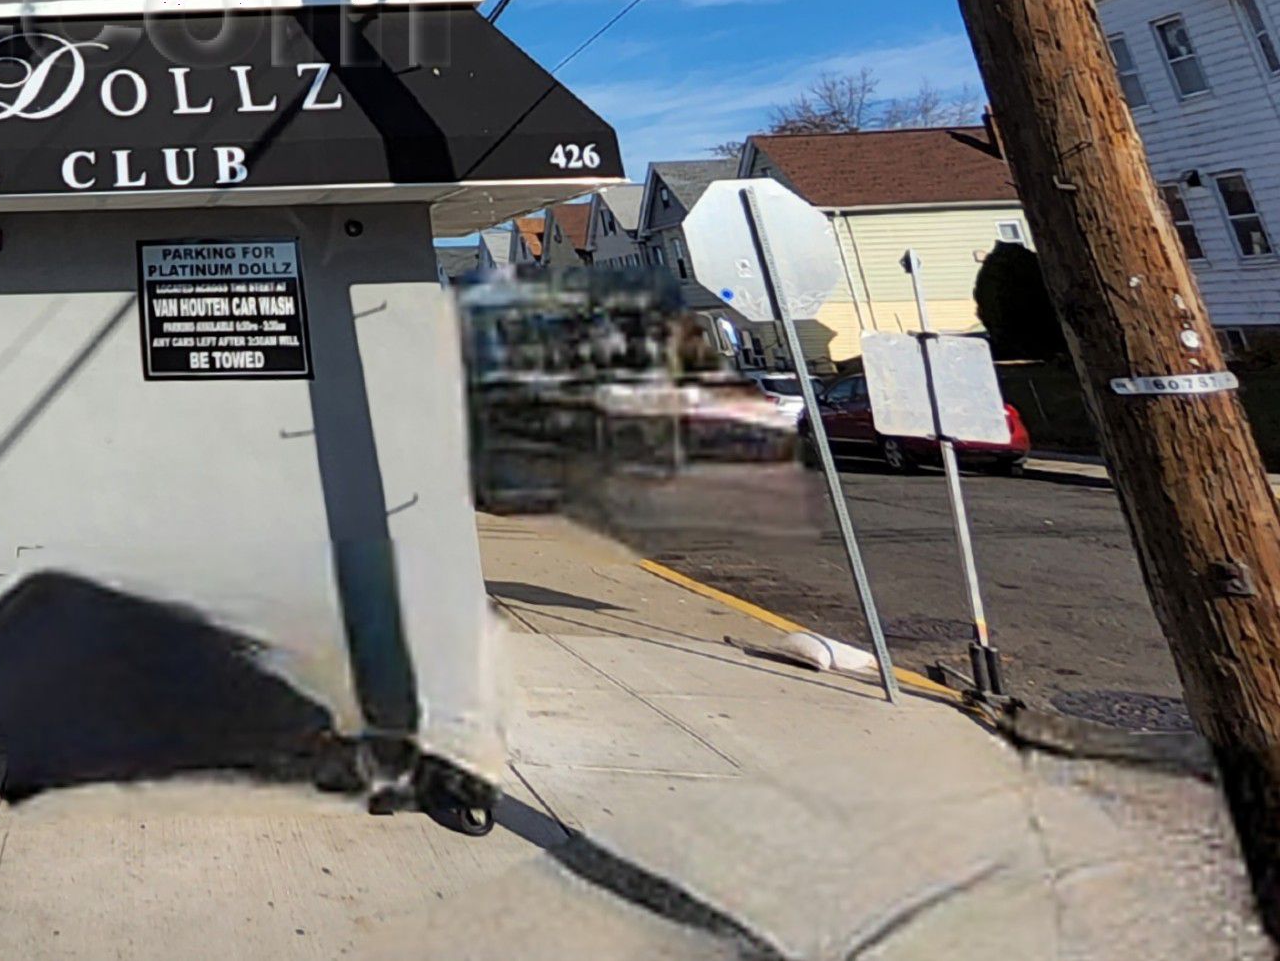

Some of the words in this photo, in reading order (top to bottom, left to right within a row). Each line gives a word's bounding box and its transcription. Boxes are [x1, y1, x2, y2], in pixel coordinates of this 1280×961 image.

[549, 143, 601, 169] 426
[61, 146, 248, 189] CLUB
[162, 246, 236, 261] PARKING
[242, 246, 275, 259] FOR
[147, 263, 233, 277] PLATINUM
[239, 262, 292, 275] DOLLZ
[152, 298, 178, 317] VAN
[179, 297, 230, 317] HOUTEN
[232, 297, 257, 316] CAR
[258, 296, 296, 316] WASH
[152, 337, 170, 347] ANY
[172, 337, 195, 347] CARS
[189, 351, 210, 369] BE
[211, 351, 265, 369] TOWED
